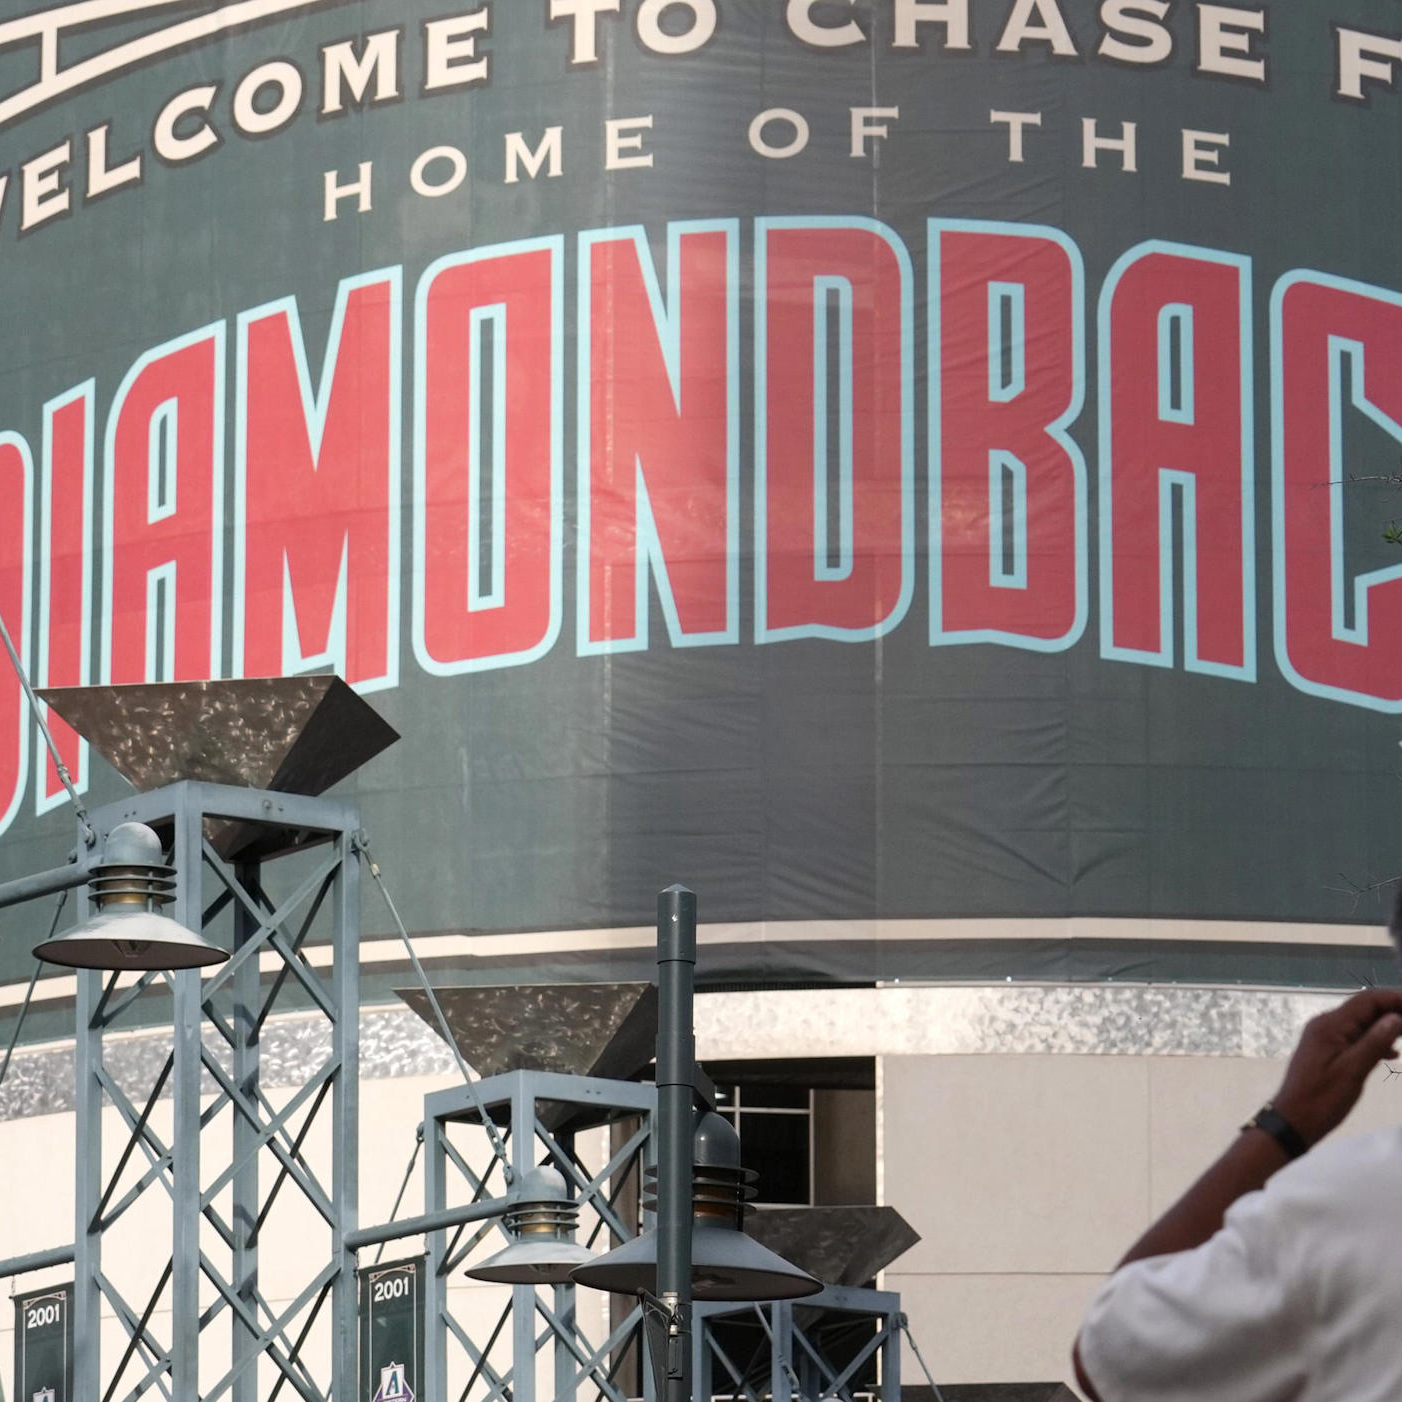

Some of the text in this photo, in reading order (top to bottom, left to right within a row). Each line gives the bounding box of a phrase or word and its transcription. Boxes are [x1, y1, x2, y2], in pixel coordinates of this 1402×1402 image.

[546, 0, 718, 65] TO
[786, 0, 1266, 83] CHASE
[323, 106, 1232, 223] HOME OF THE
[27, 1303, 60, 1329] 2001
[374, 1277, 409, 1302] 2001
